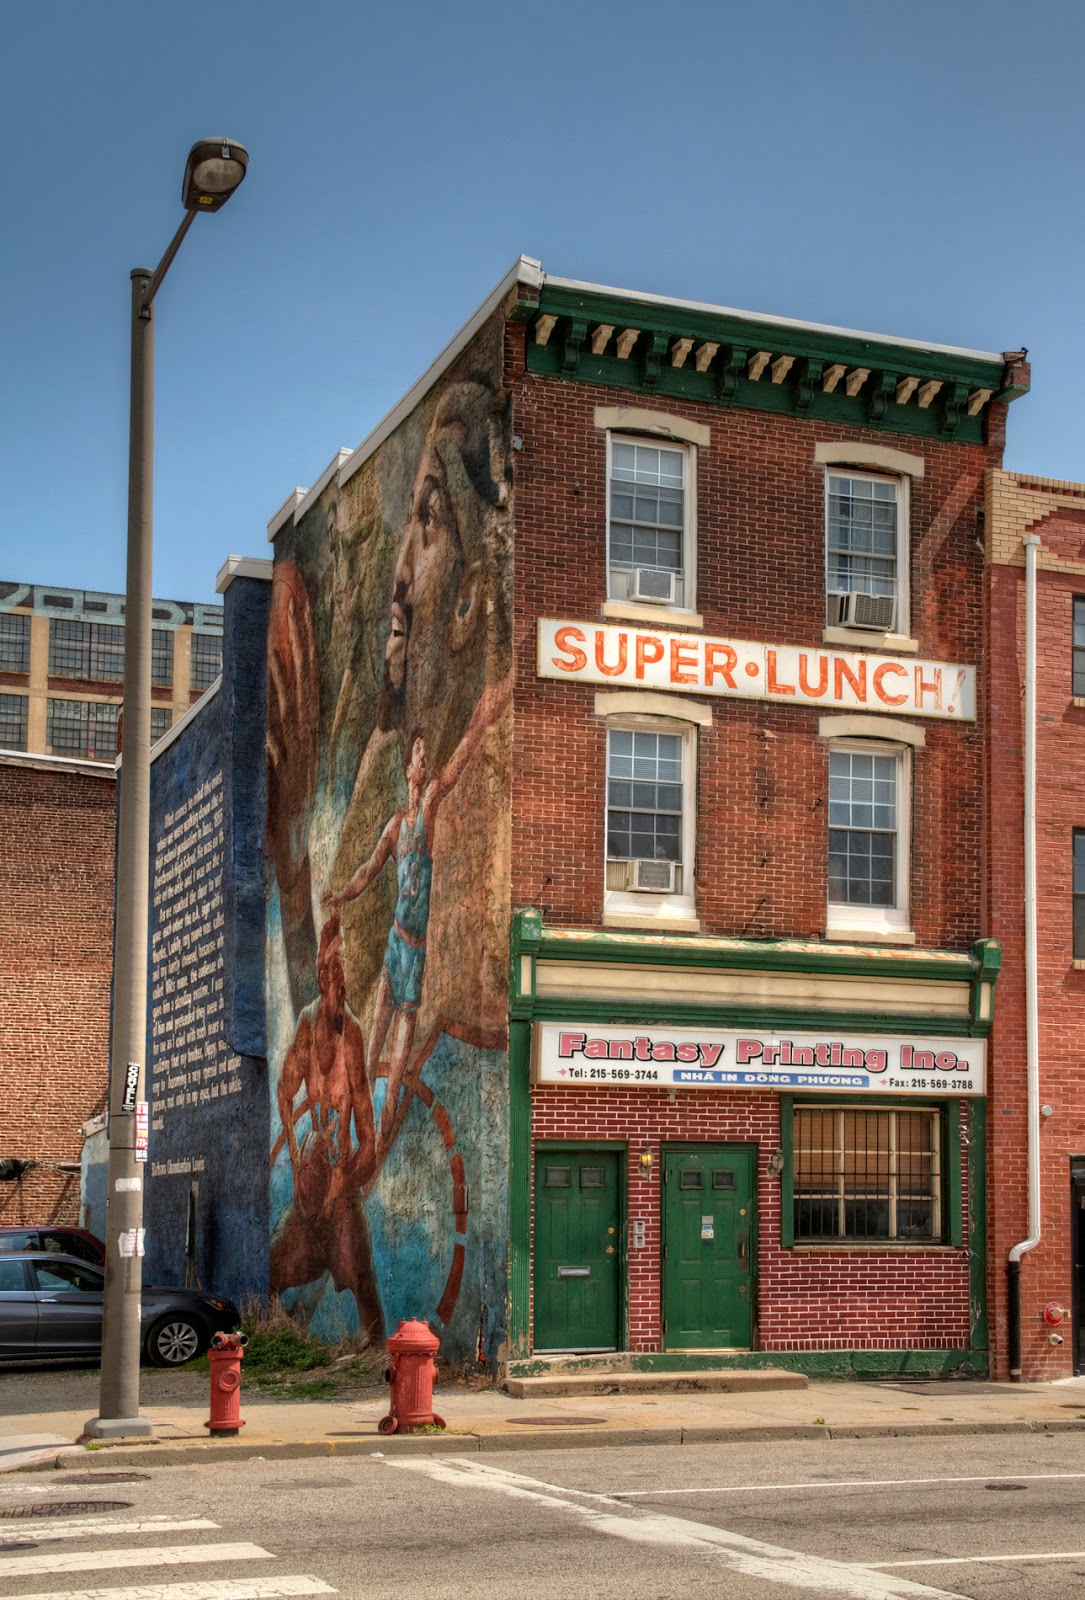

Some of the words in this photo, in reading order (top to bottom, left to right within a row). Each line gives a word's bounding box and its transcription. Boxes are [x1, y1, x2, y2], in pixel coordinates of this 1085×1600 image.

[551, 626, 738, 689] SUPER
[767, 650, 966, 713] LUNCH!
[558, 1032, 724, 1068] Fantasy
[736, 1039, 888, 1073] Printing
[900, 1044, 969, 1071] Inc.
[569, 1068, 587, 1078] Tel:
[590, 1068, 658, 1080] 215-569-3744
[722, 1073, 738, 1082] IN
[889, 1078, 909, 1087] Fax:
[911, 1079, 973, 1090] 215-569-3788
